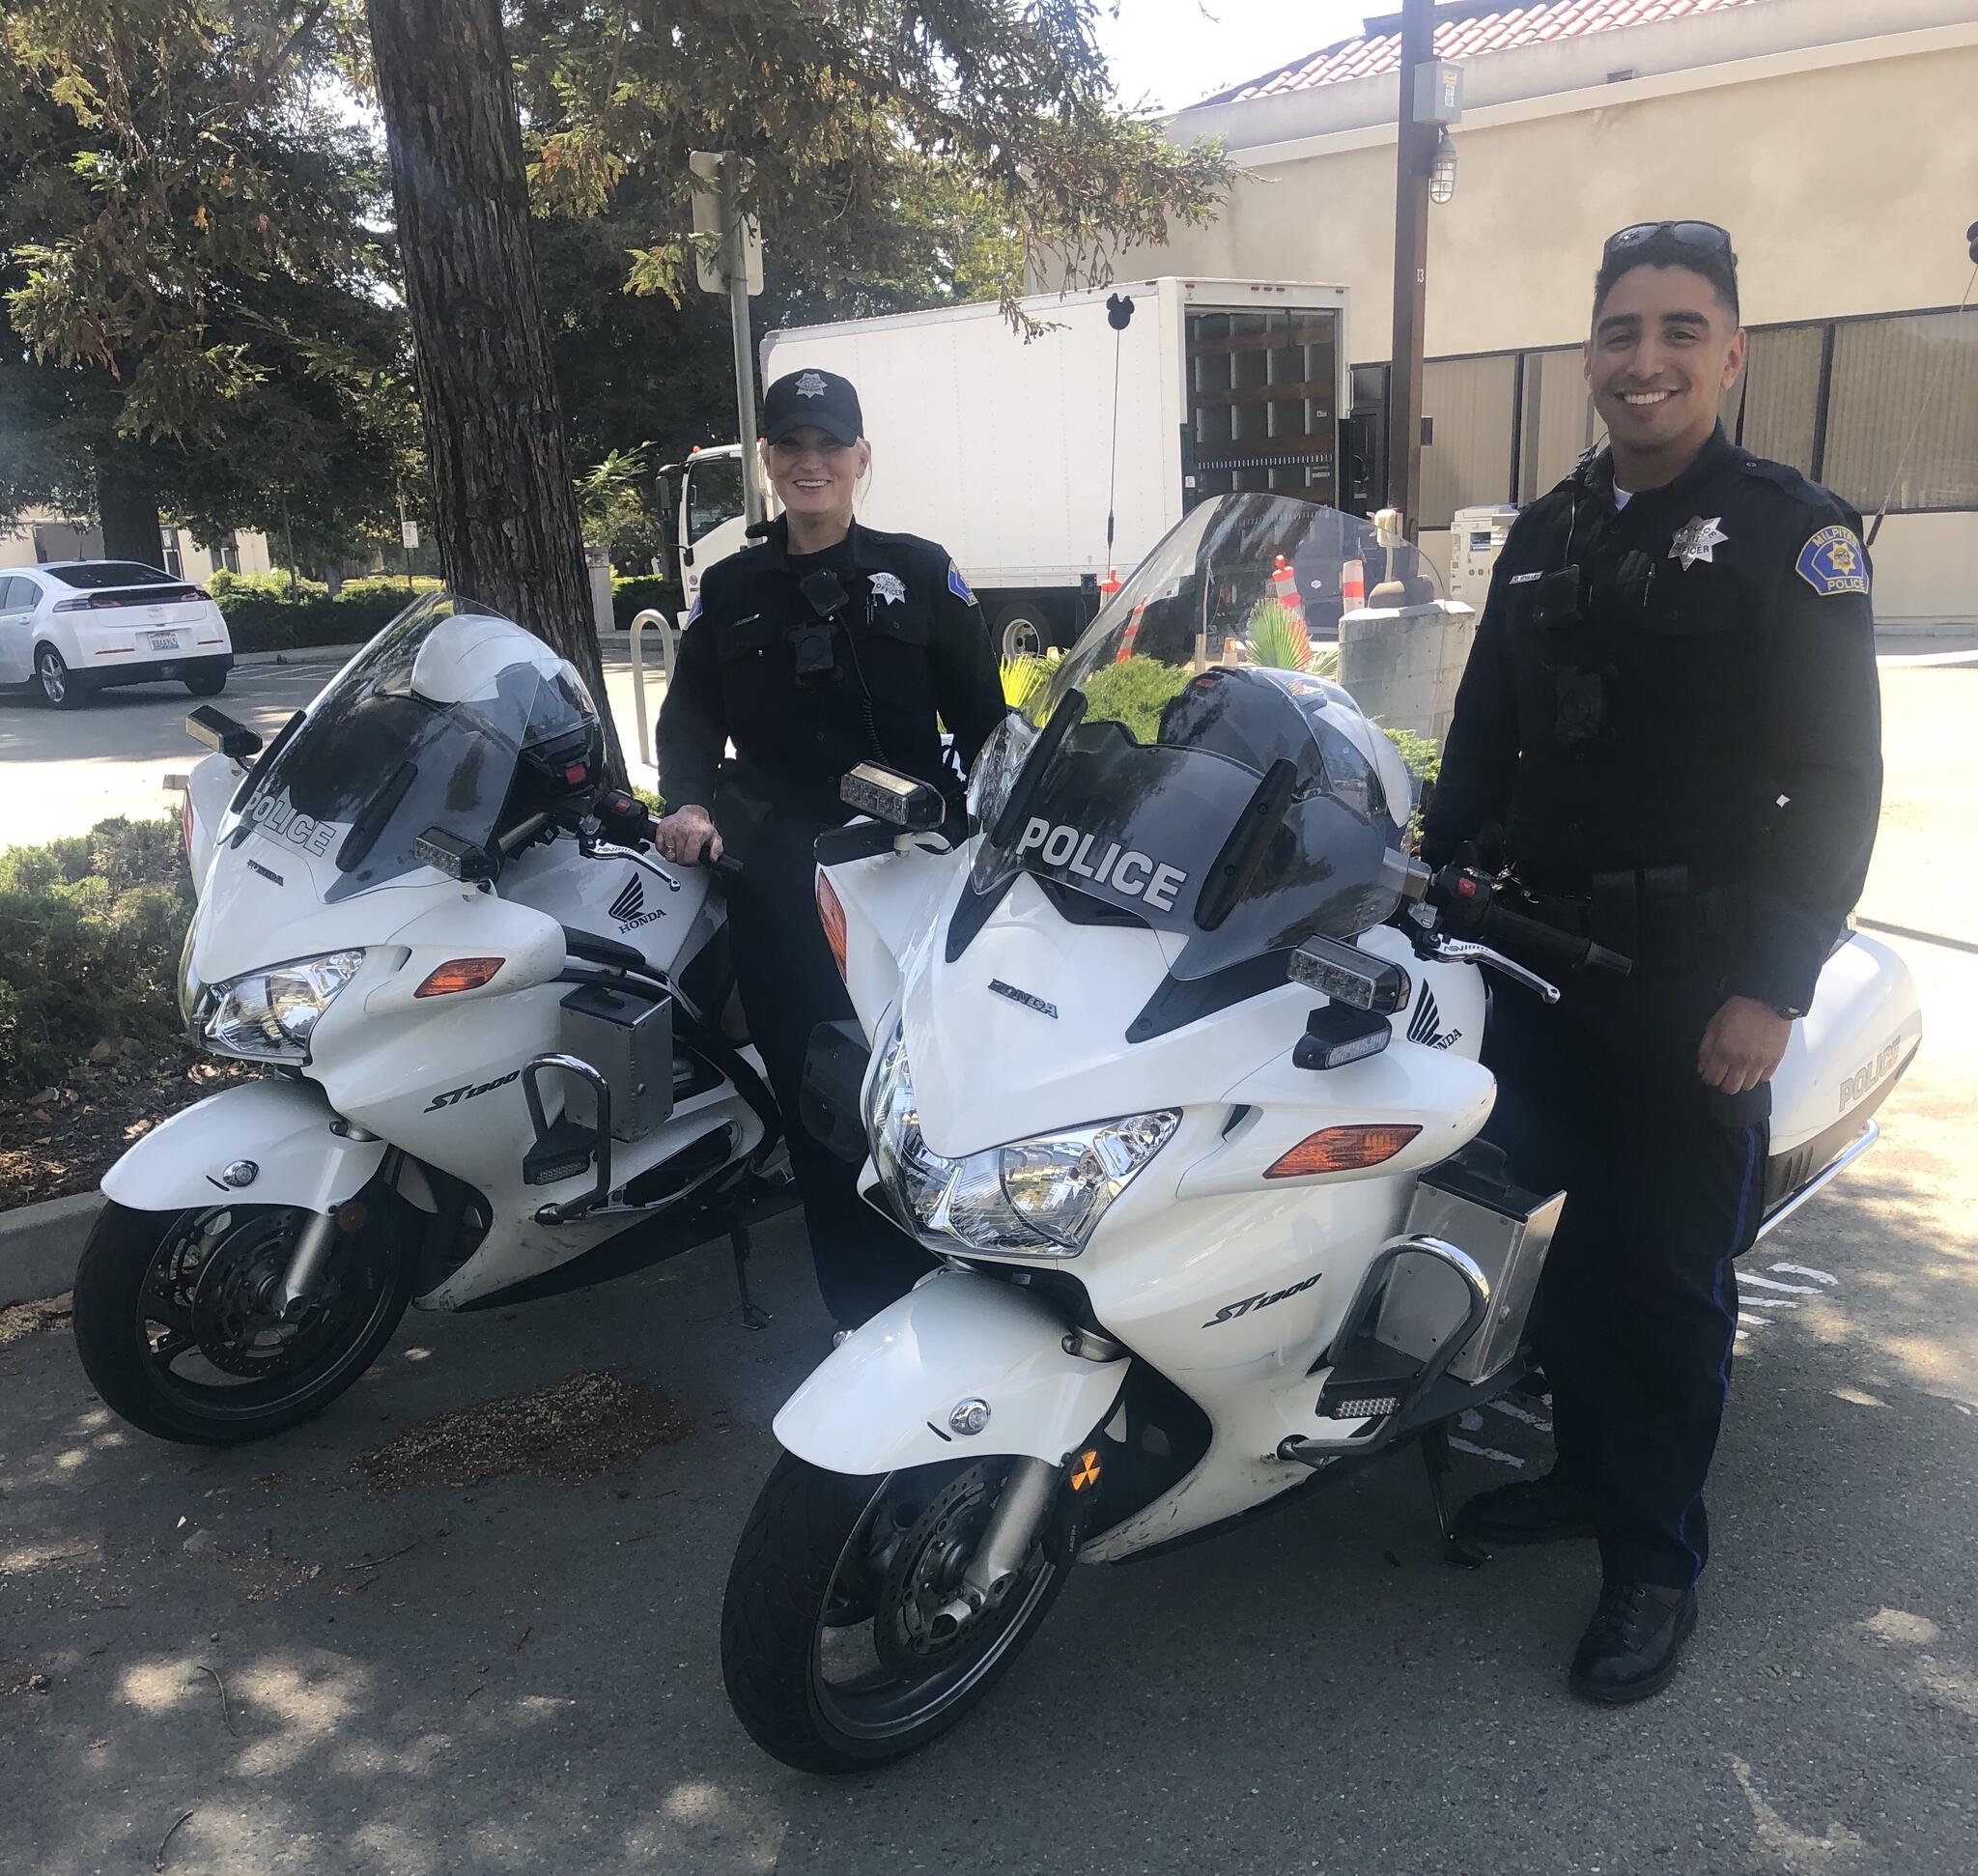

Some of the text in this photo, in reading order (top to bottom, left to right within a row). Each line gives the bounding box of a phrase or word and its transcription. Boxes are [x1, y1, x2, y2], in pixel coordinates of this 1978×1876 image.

[1416, 268, 1425, 283] 13
[1827, 579, 1865, 591] POLICE
[246, 791, 337, 858] POLICE
[1015, 816, 1187, 912] POLICE
[618, 909, 666, 934] HONDA
[987, 978, 1059, 1020] HONDA
[1437, 1028, 1462, 1051] NDA
[423, 1069, 521, 1113] ST1300
[1838, 1035, 1901, 1113] POLICE
[1201, 1272, 1323, 1329] ST1300
